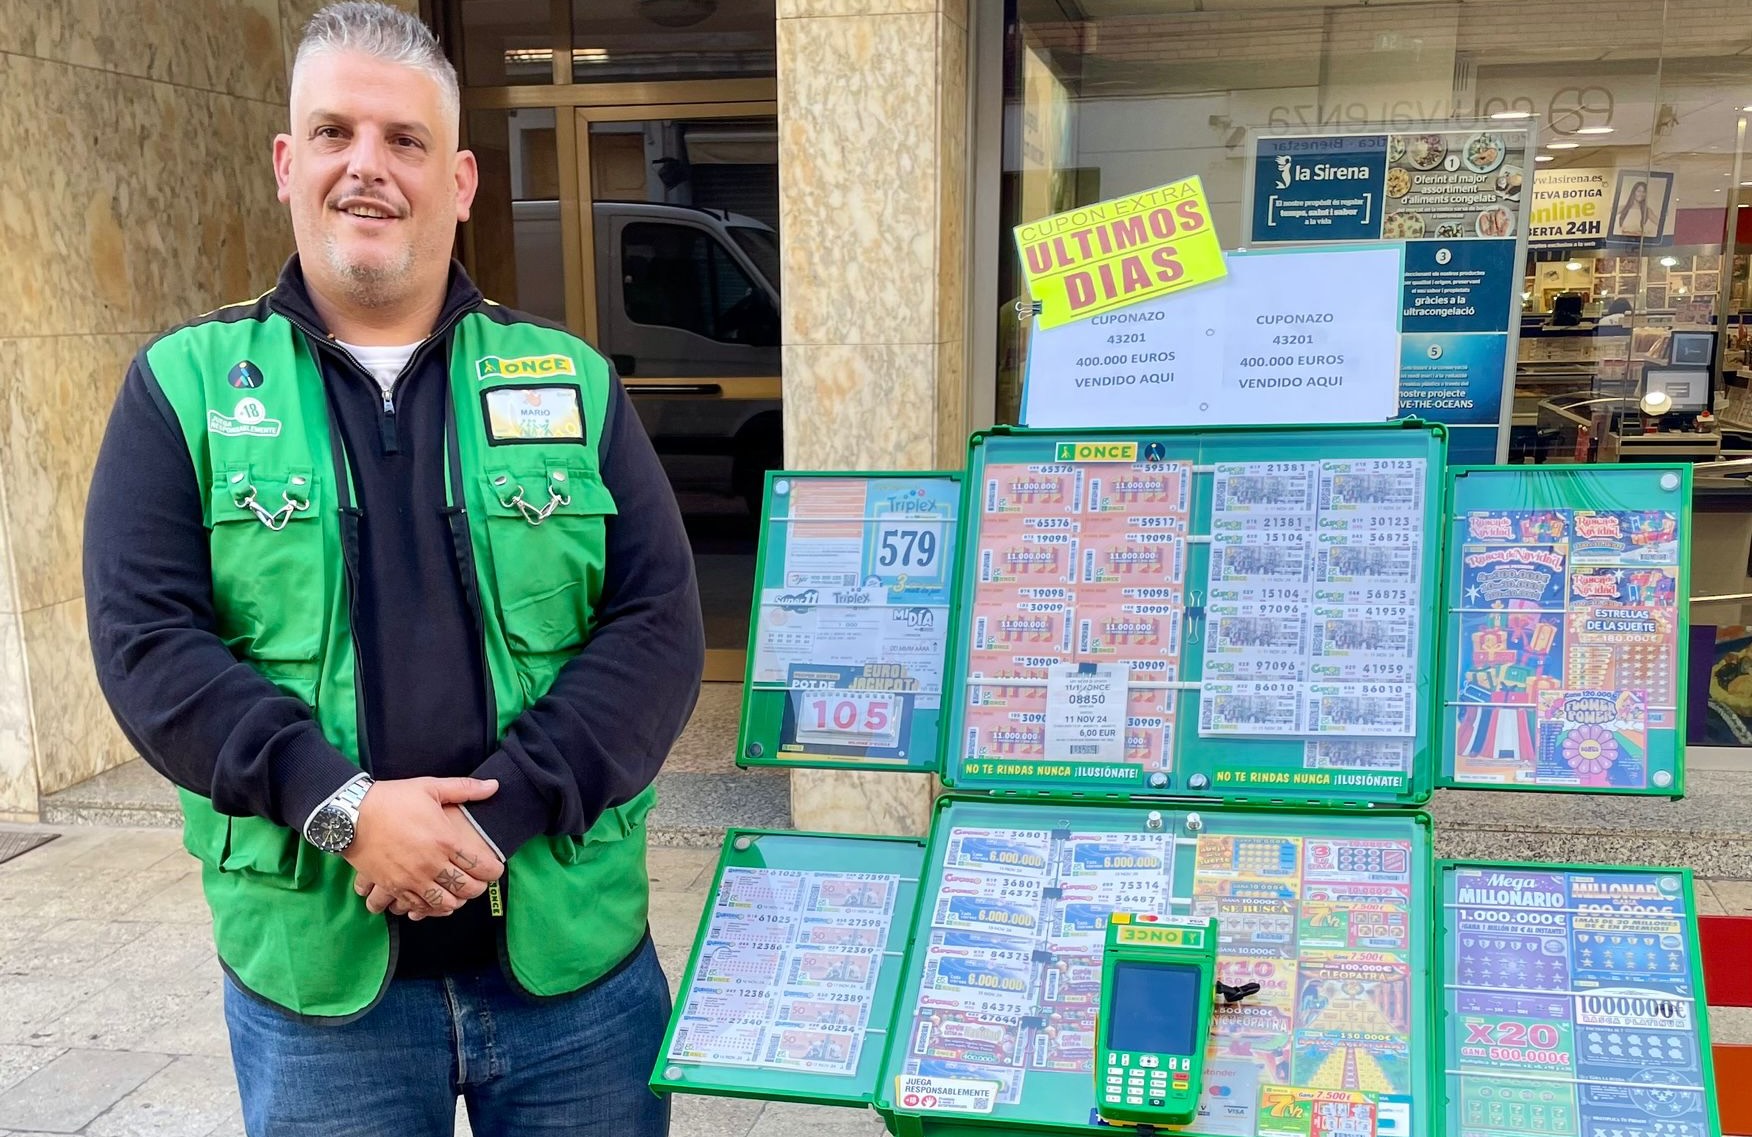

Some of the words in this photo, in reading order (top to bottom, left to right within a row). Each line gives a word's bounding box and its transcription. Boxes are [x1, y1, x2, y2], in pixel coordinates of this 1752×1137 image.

[1449, 159, 1454, 167] 1
[1295, 165, 1310, 180] la
[1314, 164, 1369, 180] Sirena
[1414, 175, 1447, 184] Oferint
[1449, 174, 1457, 183] el
[1459, 174, 1487, 184] major
[1421, 186, 1477, 194] assortiment
[1534, 191, 1560, 199] TEVA
[1562, 189, 1602, 198] BOTIGA
[1401, 195, 1448, 204] d'aliments
[1450, 194, 1496, 205] congelats
[1020, 211, 1106, 242] CUPON
[1115, 181, 1197, 216] EXTRA
[1566, 220, 1600, 235] 24H
[1025, 199, 1205, 276] ULTIMOS
[1440, 252, 1446, 261] 3
[1063, 246, 1185, 311] DIAS
[1415, 296, 1448, 306] gràcies
[1457, 296, 1466, 304] la
[1404, 307, 1475, 317] ultracongelació
[1091, 310, 1165, 326] CUPONAZO
[1256, 313, 1334, 325] CUPONAZO
[1107, 332, 1146, 344] 43201
[1272, 334, 1313, 345] 43201
[1431, 347, 1437, 355] 5
[1076, 354, 1128, 368] 400.000
[1131, 351, 1176, 365] EUROS
[1240, 355, 1294, 368] 400.000
[1298, 354, 1345, 366] EUROS
[505, 359, 568, 373] ONCE
[1075, 374, 1136, 388] VENDIDO
[1139, 372, 1175, 386] AQUI
[1239, 376, 1303, 389] VENDIDO
[1306, 375, 1343, 389] AQUI
[1428, 390, 1466, 399] projecte
[1079, 446, 1132, 459] ONCE
[1041, 465, 1073, 473] 65376
[1144, 464, 1178, 472] 59517
[1267, 464, 1306, 472] 21381
[1373, 461, 1413, 469] 30123
[1037, 519, 1070, 528] 65376
[1141, 518, 1175, 526] 59517
[1263, 518, 1302, 527] 21381
[1370, 517, 1410, 526] 30123
[1037, 535, 1068, 543] 19098
[1140, 534, 1173, 543] 19098
[1265, 534, 1303, 542] 15104
[1369, 533, 1410, 542] 56875
[879, 529, 936, 567] 579
[1033, 589, 1064, 598] 19098
[1137, 589, 1169, 598] 19098
[1261, 589, 1299, 598] 15104
[1366, 590, 1407, 599] 56875
[1030, 603, 1063, 612] 30909
[1135, 605, 1169, 614] 30909
[1259, 605, 1299, 613] 97096
[1365, 607, 1406, 616] 41959
[1594, 609, 1649, 619] ESTRELLAS
[1586, 620, 1599, 632] DE
[1600, 621, 1616, 632] LA
[1616, 622, 1655, 633] SUERTE
[1026, 658, 1059, 666] 30909
[1132, 661, 1165, 670] 30909
[1256, 661, 1296, 670] 97096
[1362, 664, 1404, 673] 41959
[792, 680, 819, 689] POT
[819, 681, 836, 689] DE
[1362, 685, 1402, 693] 86010
[1069, 694, 1105, 704] 08850
[812, 700, 889, 730] 105
[1127, 718, 1161, 727] 30909
[1079, 729, 1097, 737] 6,00
[1099, 729, 1116, 737] EUR
[966, 763, 979, 773] NO
[982, 764, 994, 774] TE
[997, 765, 1033, 775] RINDAS
[1037, 766, 1071, 776] NUNCA
[1074, 766, 1138, 779] ¡ILUSIÓNATE!
[1217, 771, 1231, 782] NO
[1235, 772, 1246, 782] TE
[1250, 772, 1289, 783] RINDAS
[1293, 773, 1330, 784] NUNCA
[1334, 774, 1402, 787] ¡ILUSIÓNATE!
[1123, 834, 1163, 843] 75314
[1487, 874, 1537, 891] Mega
[1000, 889, 1039, 898] 84375
[1459, 888, 1565, 907] MILLONARIO
[491, 889, 500, 913] ONCE
[1222, 905, 1241, 913] SE
[1244, 905, 1289, 913] BUSCA
[1459, 910, 1566, 925] 1.000.000€
[1124, 929, 1177, 942] ONCE
[841, 946, 874, 954] 72389
[1340, 964, 1392, 972] 100.000€
[1319, 970, 1387, 982] CLEOPATRA
[981, 1003, 1021, 1013] 84375
[1582, 1015, 1621, 1025] RASCA
[1462, 1048, 1486, 1056] GANA
[1489, 1048, 1570, 1064] 500.000€
[906, 1078, 932, 1086] JUEGA
[905, 1086, 990, 1097] RESPONSABLEMENTE
